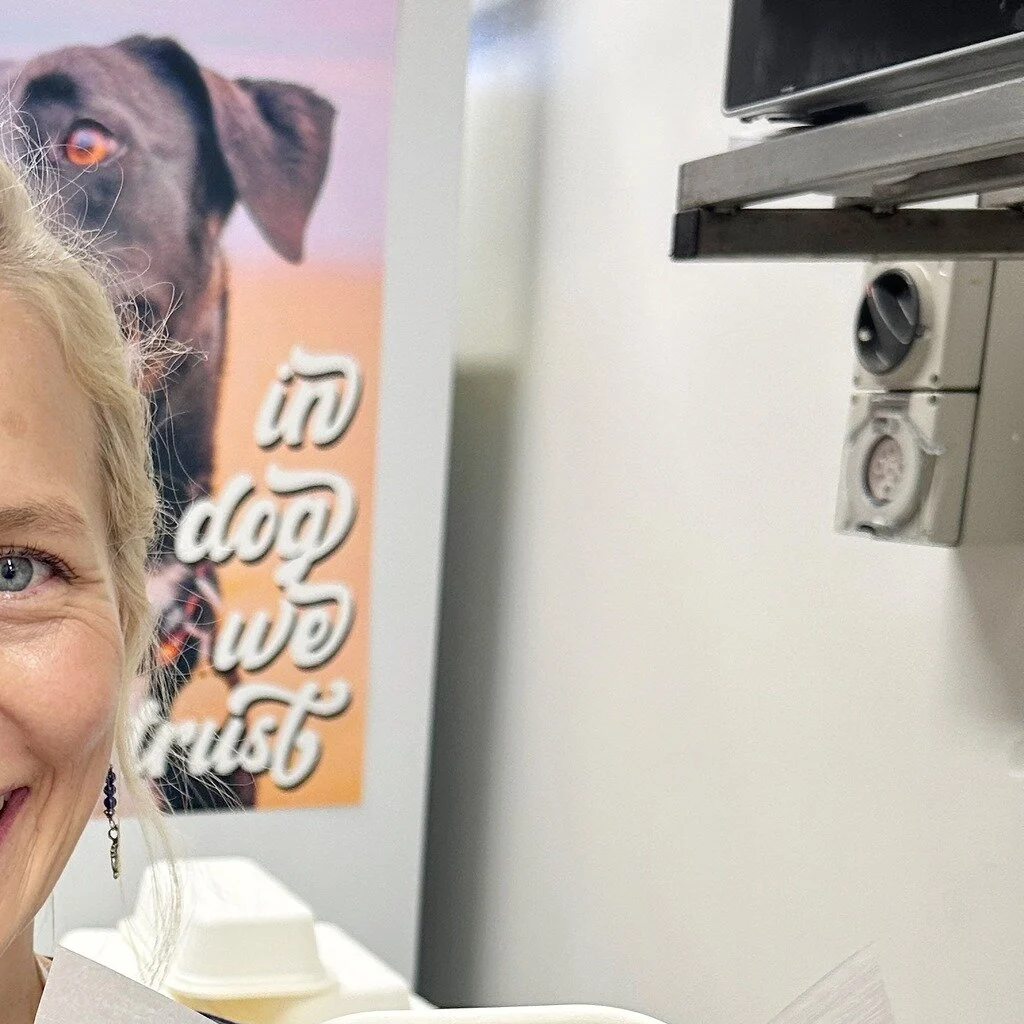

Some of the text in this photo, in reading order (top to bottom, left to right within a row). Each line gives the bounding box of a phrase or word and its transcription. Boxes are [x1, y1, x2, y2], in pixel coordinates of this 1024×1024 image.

[256, 346, 363, 448] in
[175, 465, 357, 588] dog
[212, 584, 355, 673] we
